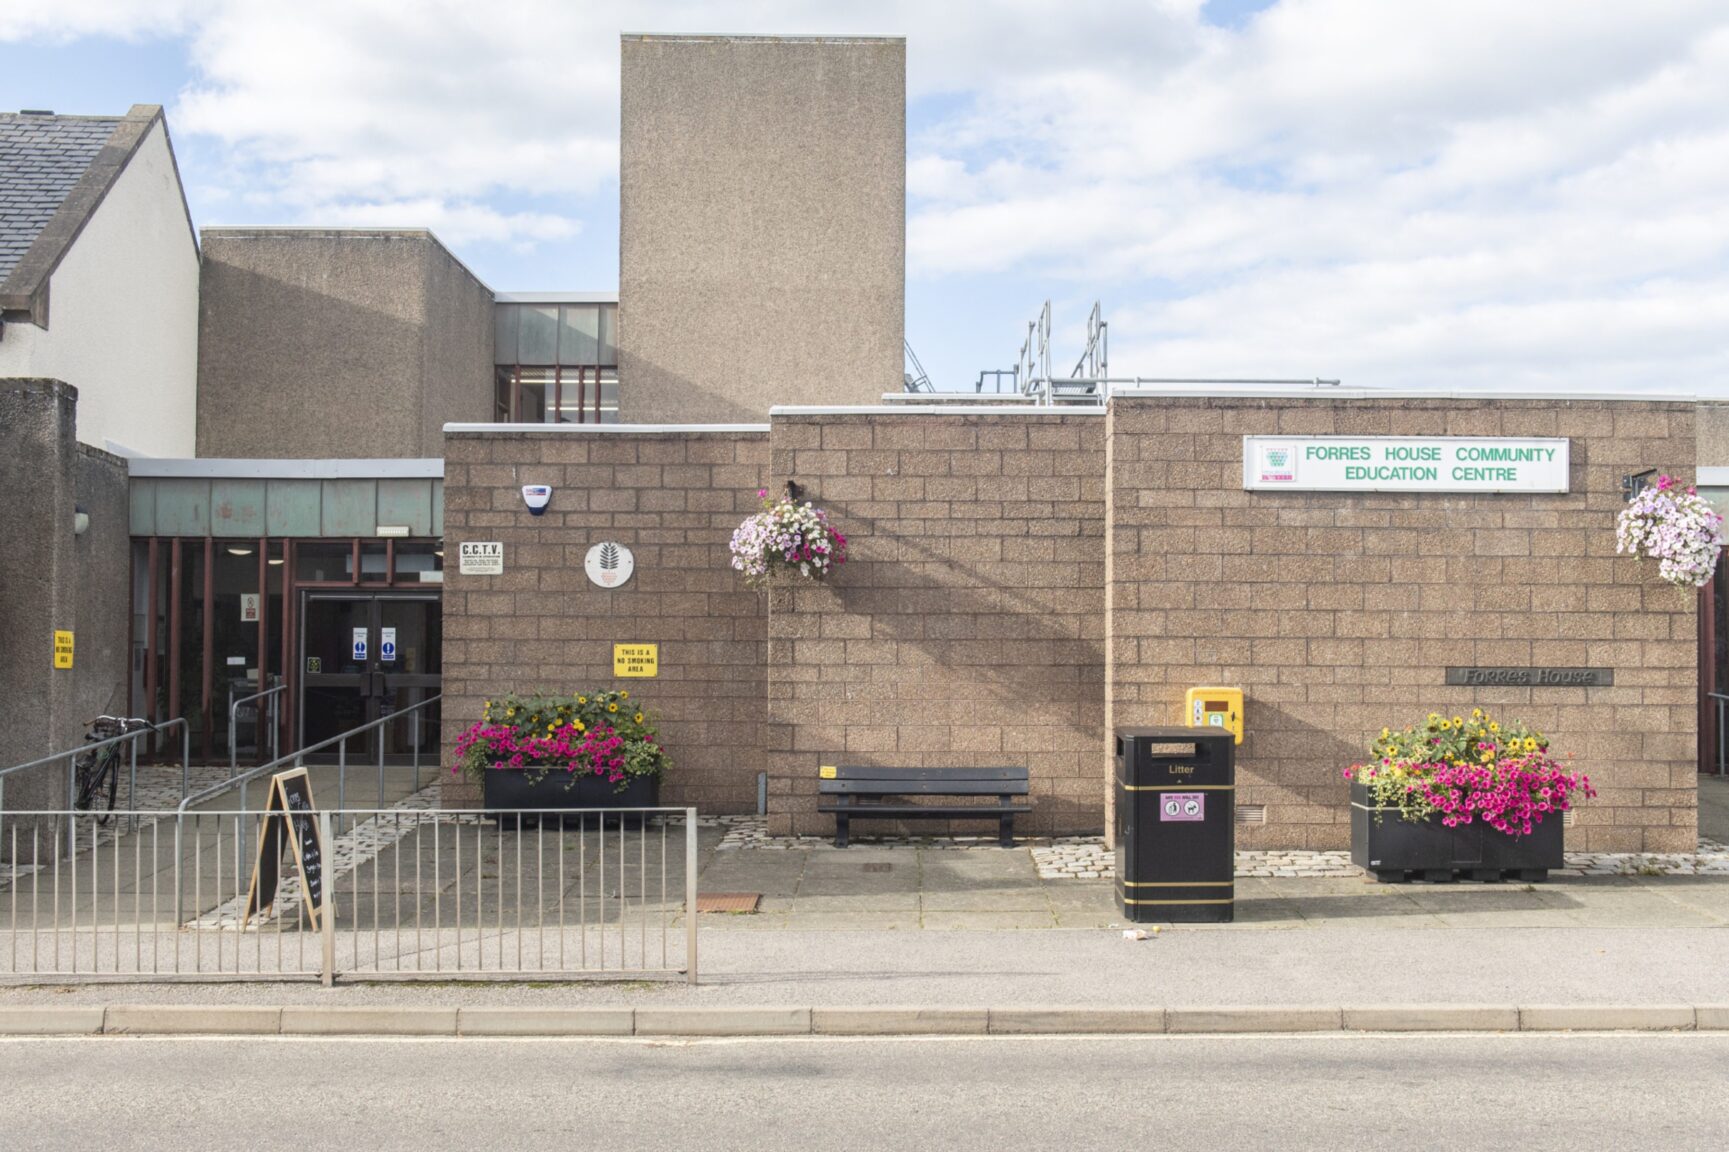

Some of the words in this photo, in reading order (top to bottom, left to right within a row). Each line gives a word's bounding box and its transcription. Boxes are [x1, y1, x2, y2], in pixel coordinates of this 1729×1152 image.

[1306, 446, 1371, 461] FORRES
[1385, 446, 1442, 461] HOUSE
[1455, 447, 1556, 462] COMMUNITY
[1345, 466, 1438, 481] EDUCATION
[1451, 467, 1518, 481] CENTRE
[462, 544, 501, 555] C.C.T.V.
[627, 657, 655, 665] SMOKING
[1169, 764, 1195, 774] Litter
